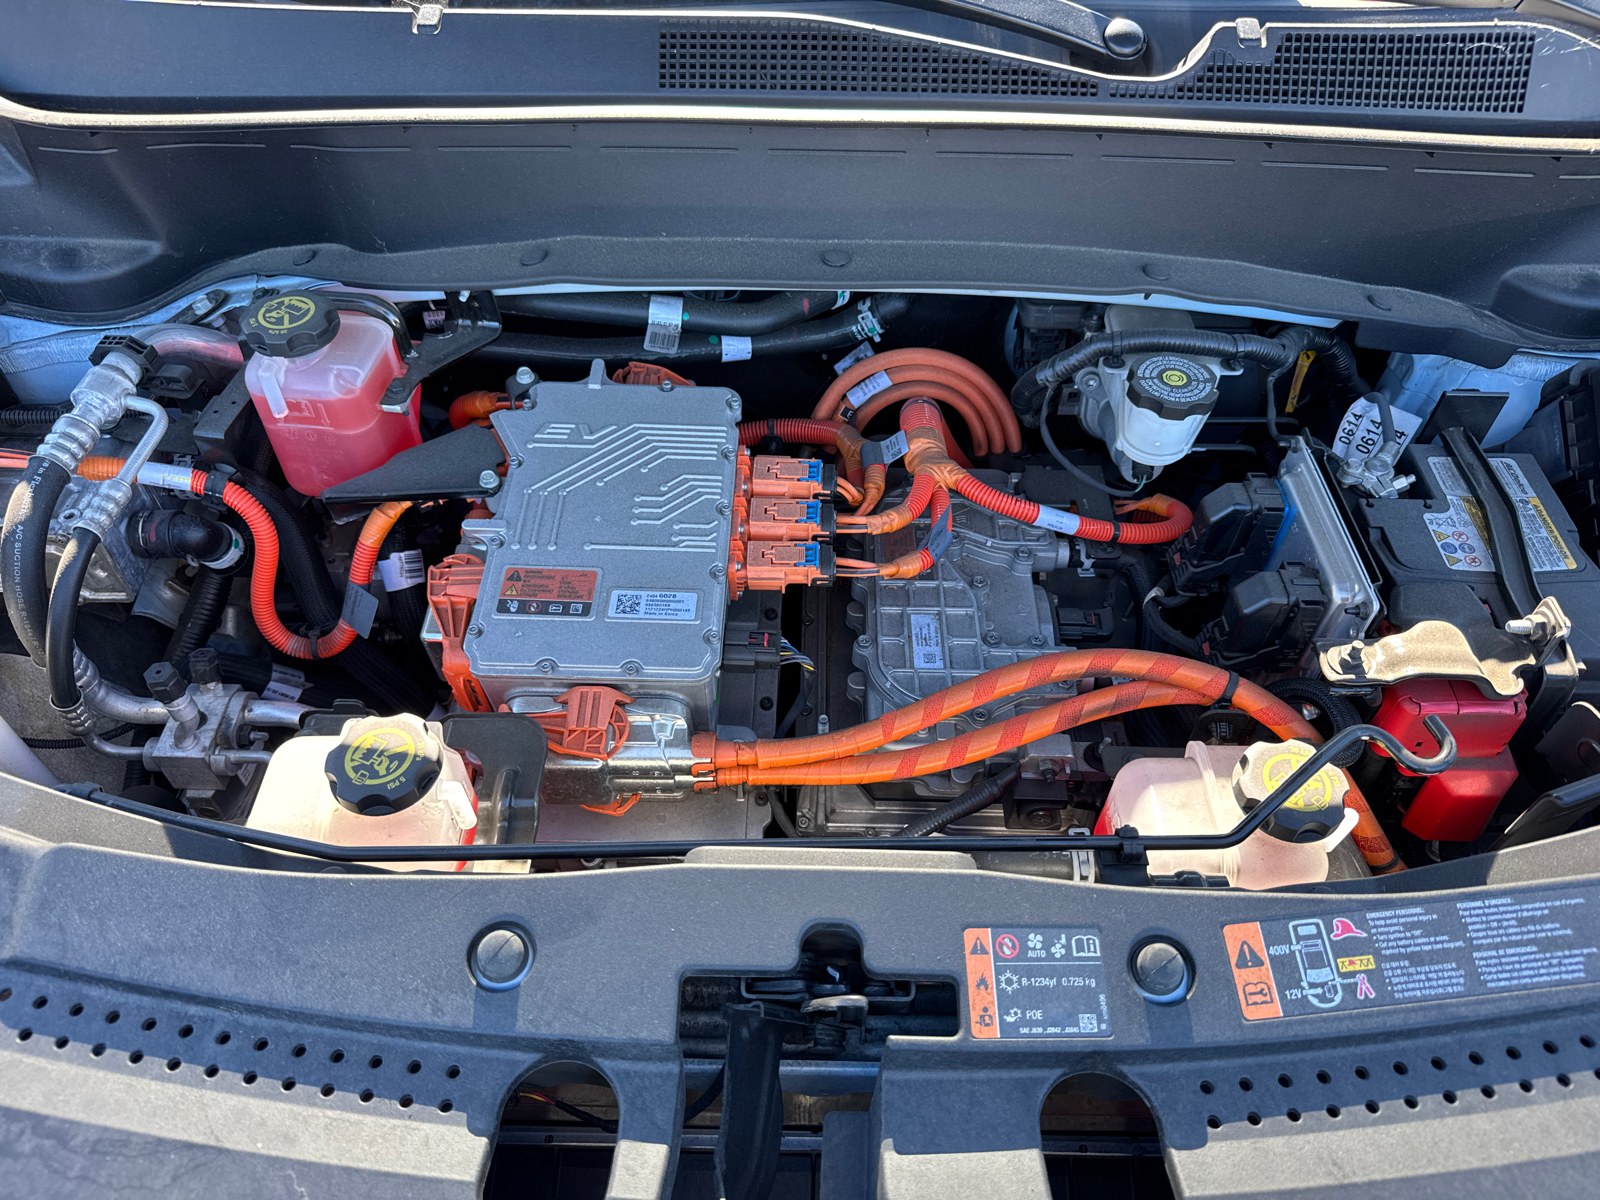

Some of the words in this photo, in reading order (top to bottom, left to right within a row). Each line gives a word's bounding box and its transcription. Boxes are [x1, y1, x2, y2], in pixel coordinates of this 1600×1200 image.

[1339, 412, 1363, 445] 0614
[1356, 419, 1382, 454] 0614
[16, 524, 24, 539] A/C
[16, 585, 25, 609] HOSE
[387, 781, 400, 790] PSI
[1366, 910, 1394, 919] EMERGENCY
[1268, 944, 1291, 956] 400V
[1021, 977, 1056, 988] R-1234yf
[1062, 977, 1084, 986] 0.725
[1085, 978, 1096, 988] kg
[1285, 990, 1302, 1000] 12V
[1026, 1010, 1043, 1019] POE
